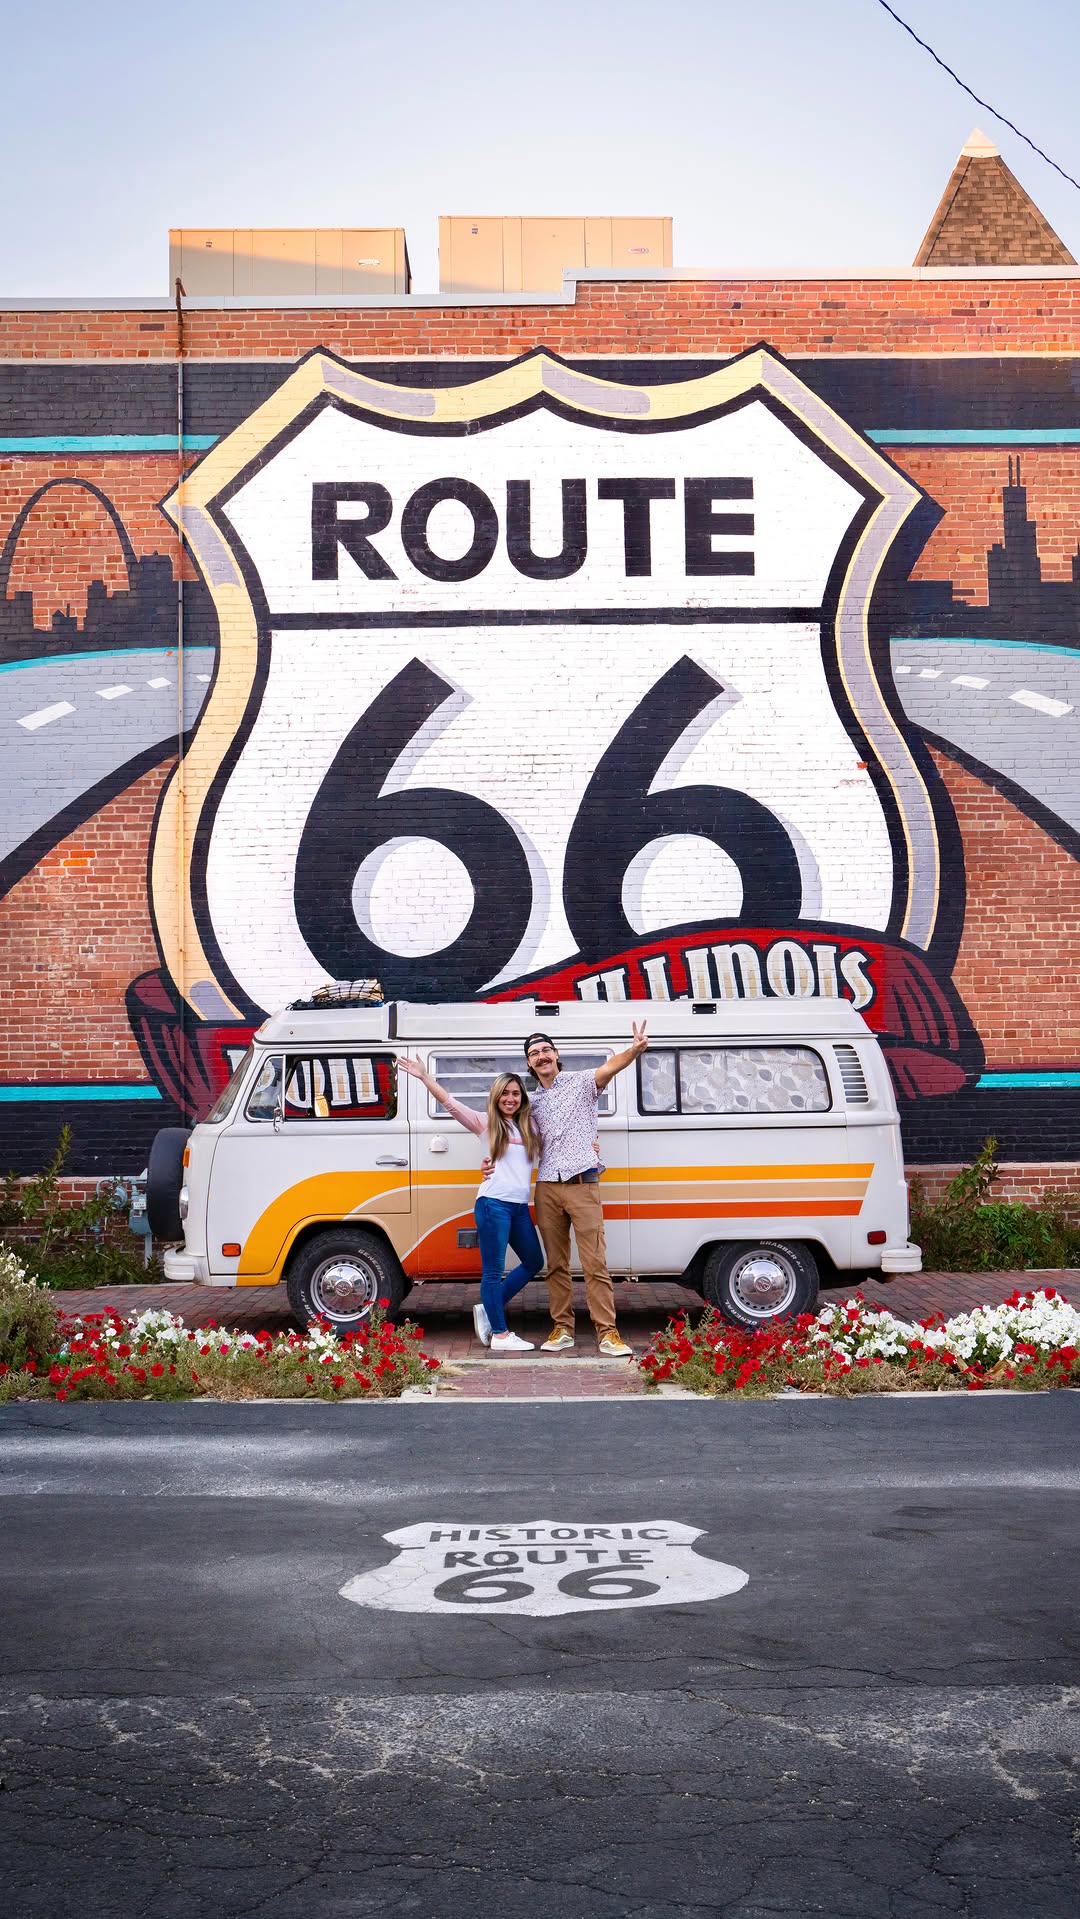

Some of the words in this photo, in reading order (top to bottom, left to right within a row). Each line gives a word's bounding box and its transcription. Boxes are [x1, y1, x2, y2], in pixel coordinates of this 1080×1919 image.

[311, 477, 755, 582] ROUTE
[294, 654, 804, 1000] 66
[760, 1240, 797, 1260] GRABBER
[358, 1249, 385, 1281] GENERAL
[725, 1299, 758, 1326] GENERAL
[430, 1528, 669, 1543] HISTORIC
[444, 1549, 654, 1568] ROUTE
[434, 1565, 661, 1604] 66
